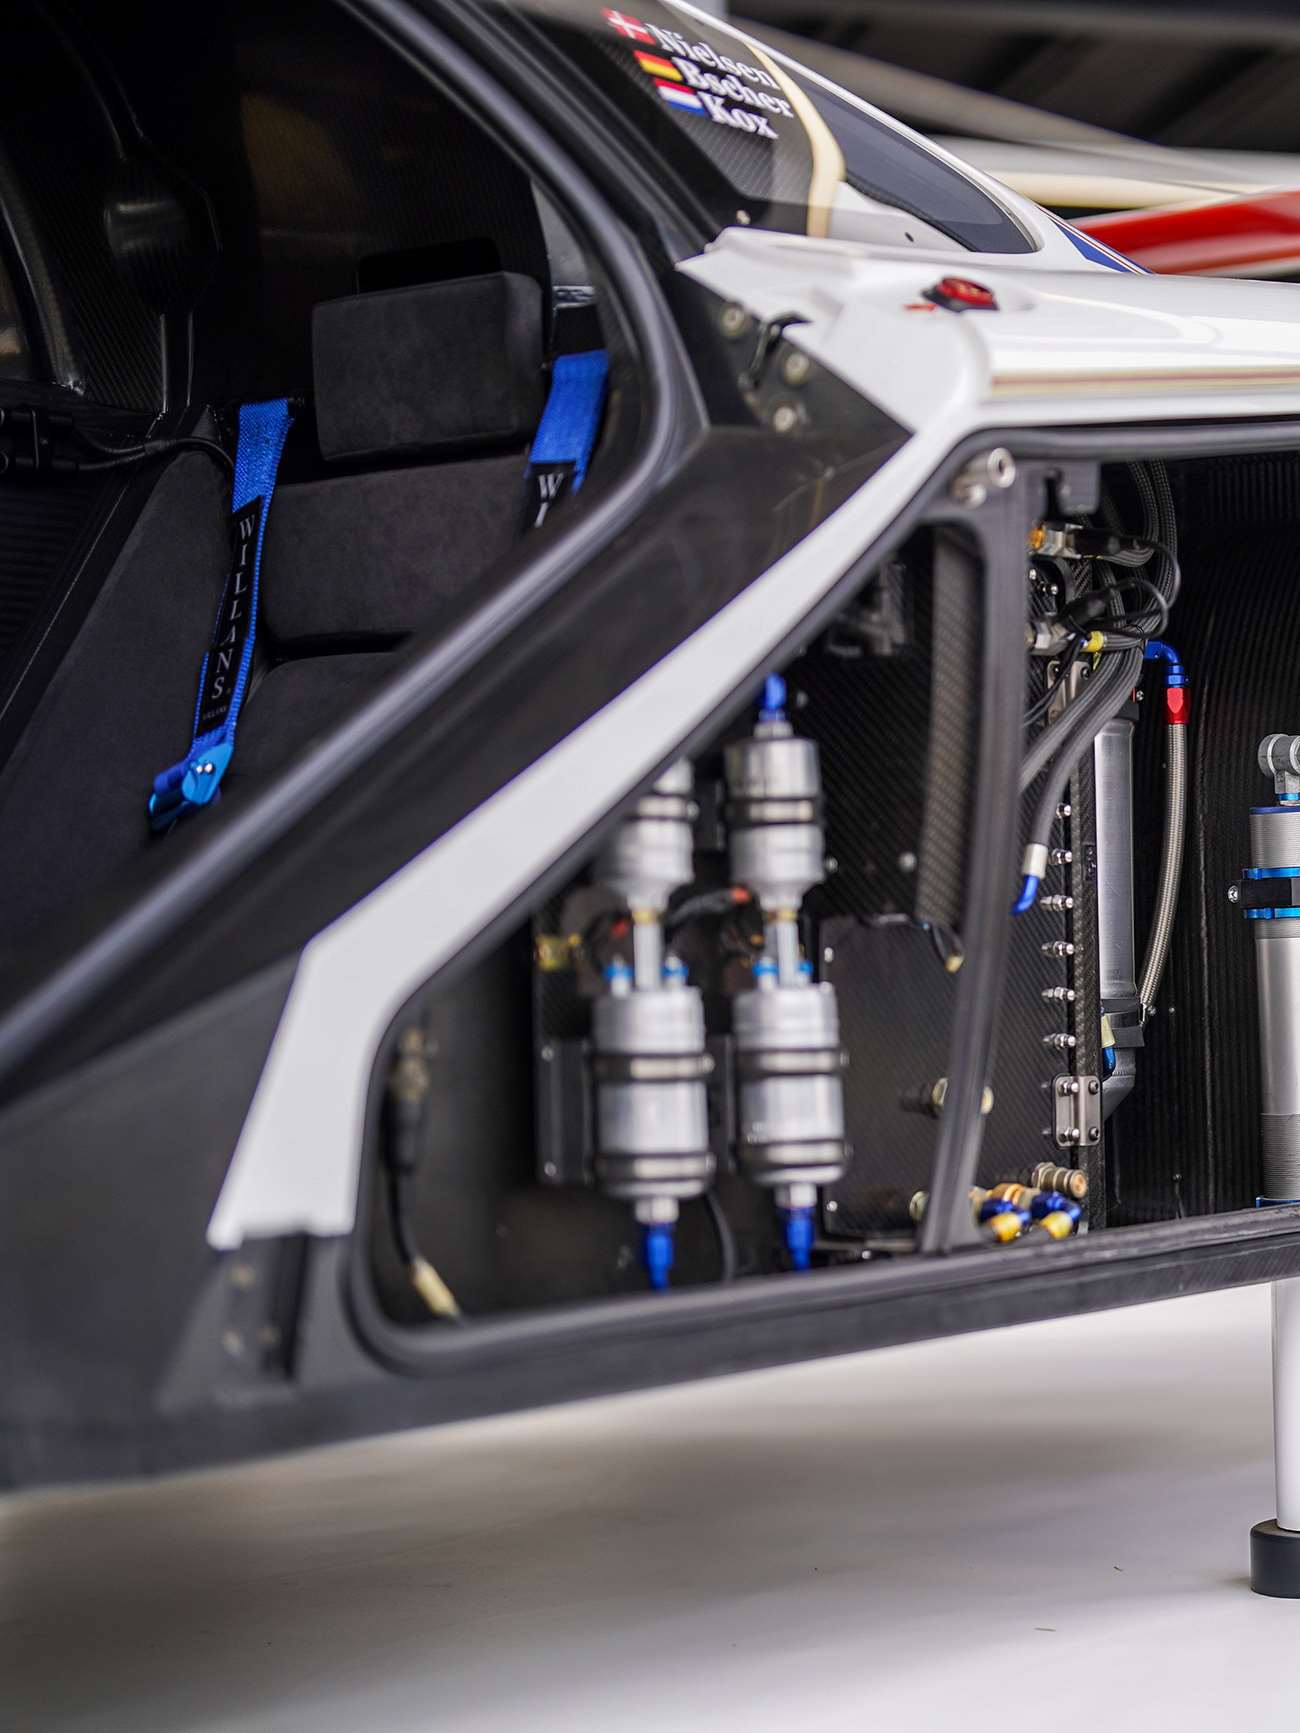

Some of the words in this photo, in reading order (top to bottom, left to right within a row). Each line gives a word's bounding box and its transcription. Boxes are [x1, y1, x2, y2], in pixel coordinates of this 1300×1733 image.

[644, 23, 781, 90] Nielsen
[697, 91, 778, 139] Kox
[211, 514, 256, 699] WILLANS
